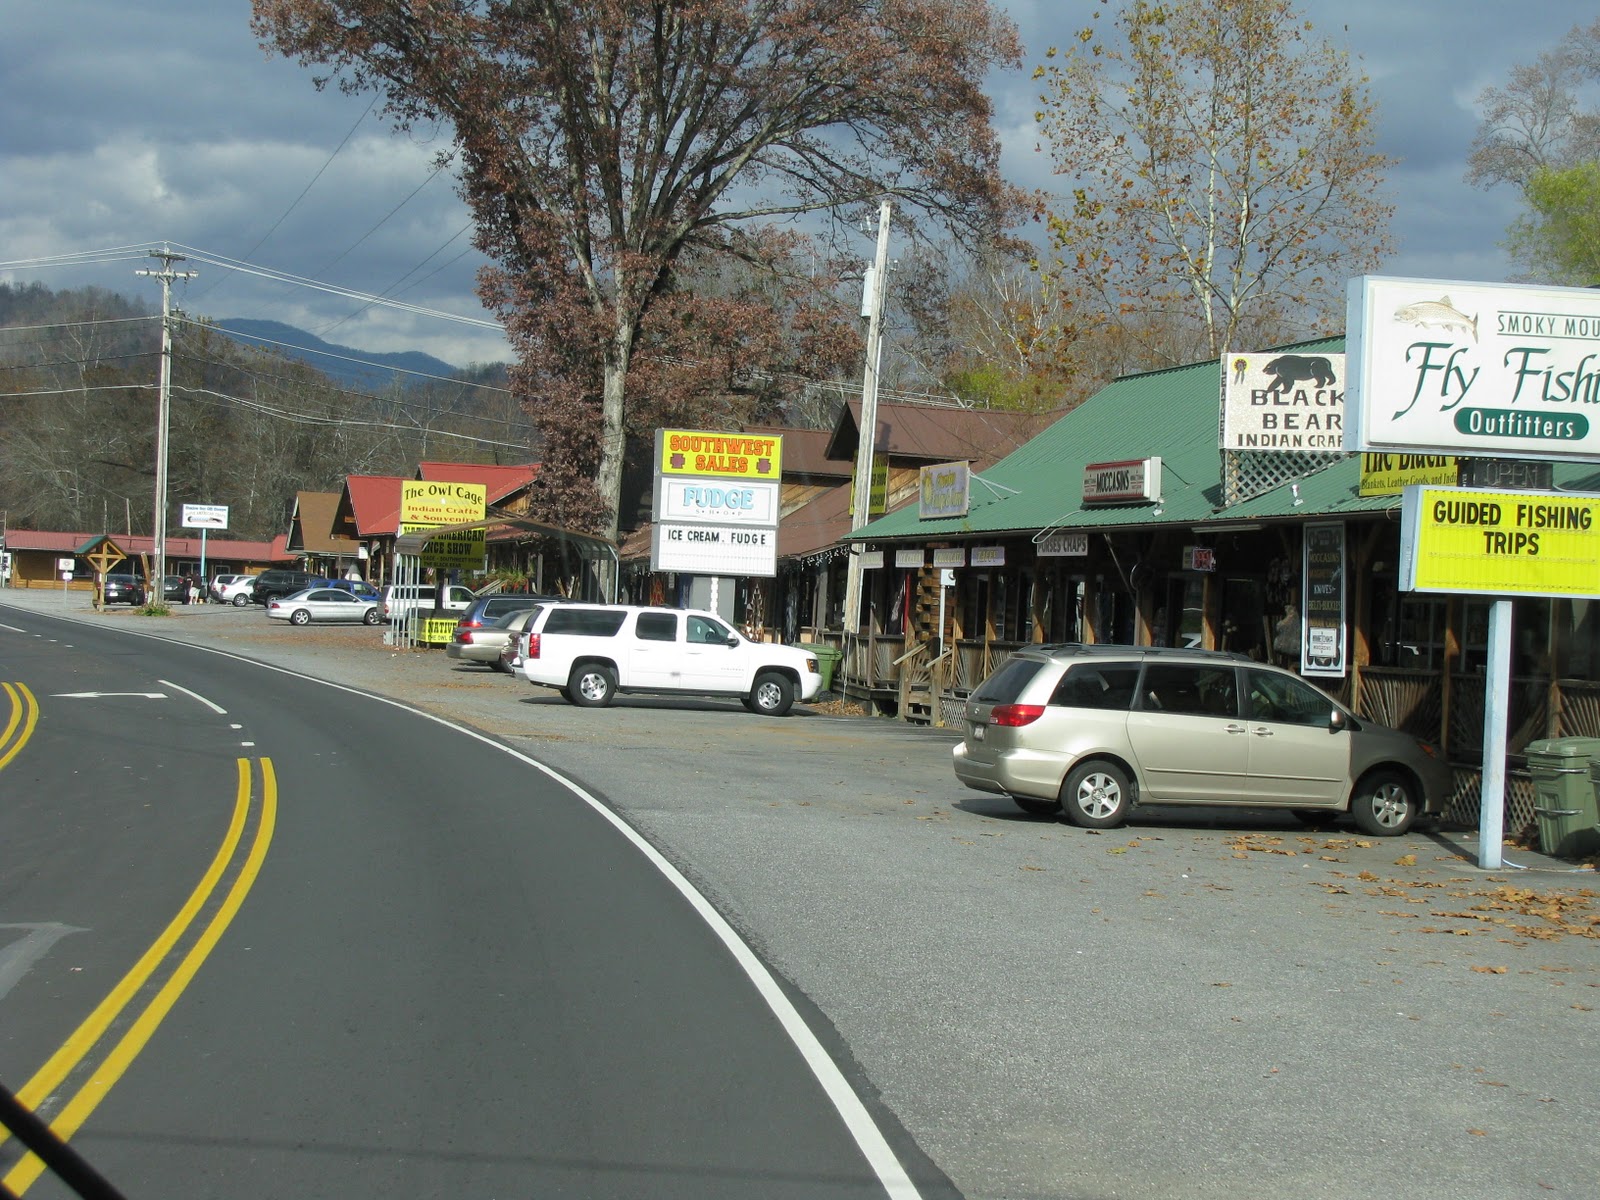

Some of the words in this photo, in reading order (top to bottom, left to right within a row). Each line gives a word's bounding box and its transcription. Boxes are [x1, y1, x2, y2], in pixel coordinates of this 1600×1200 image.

[1497, 314, 1556, 334] SMOKY
[1391, 341, 1481, 421] Fly
[1251, 389, 1344, 406] BLACK
[1262, 413, 1342, 430] BEAR
[1469, 410, 1574, 438] Outfitters
[670, 434, 775, 456] SOUTHWEST
[1238, 433, 1302, 447] INDIAN
[695, 455, 749, 473] SALES
[1096, 470, 1130, 493] MOCCASINS
[1487, 463, 1538, 488] OPEN
[405, 487, 424, 500] The
[428, 484, 452, 495] Owl
[456, 486, 483, 505] Cage
[683, 486, 755, 510] FUDGE
[407, 505, 442, 513] Indian
[446, 507, 479, 515] Crafts
[1433, 500, 1501, 525] GUIDED
[1516, 505, 1592, 530] FISHING
[668, 529, 683, 541] ICE
[731, 532, 766, 545] FUDGE
[1484, 531, 1540, 555] TRIPS
[447, 542, 472, 555] SHOW
